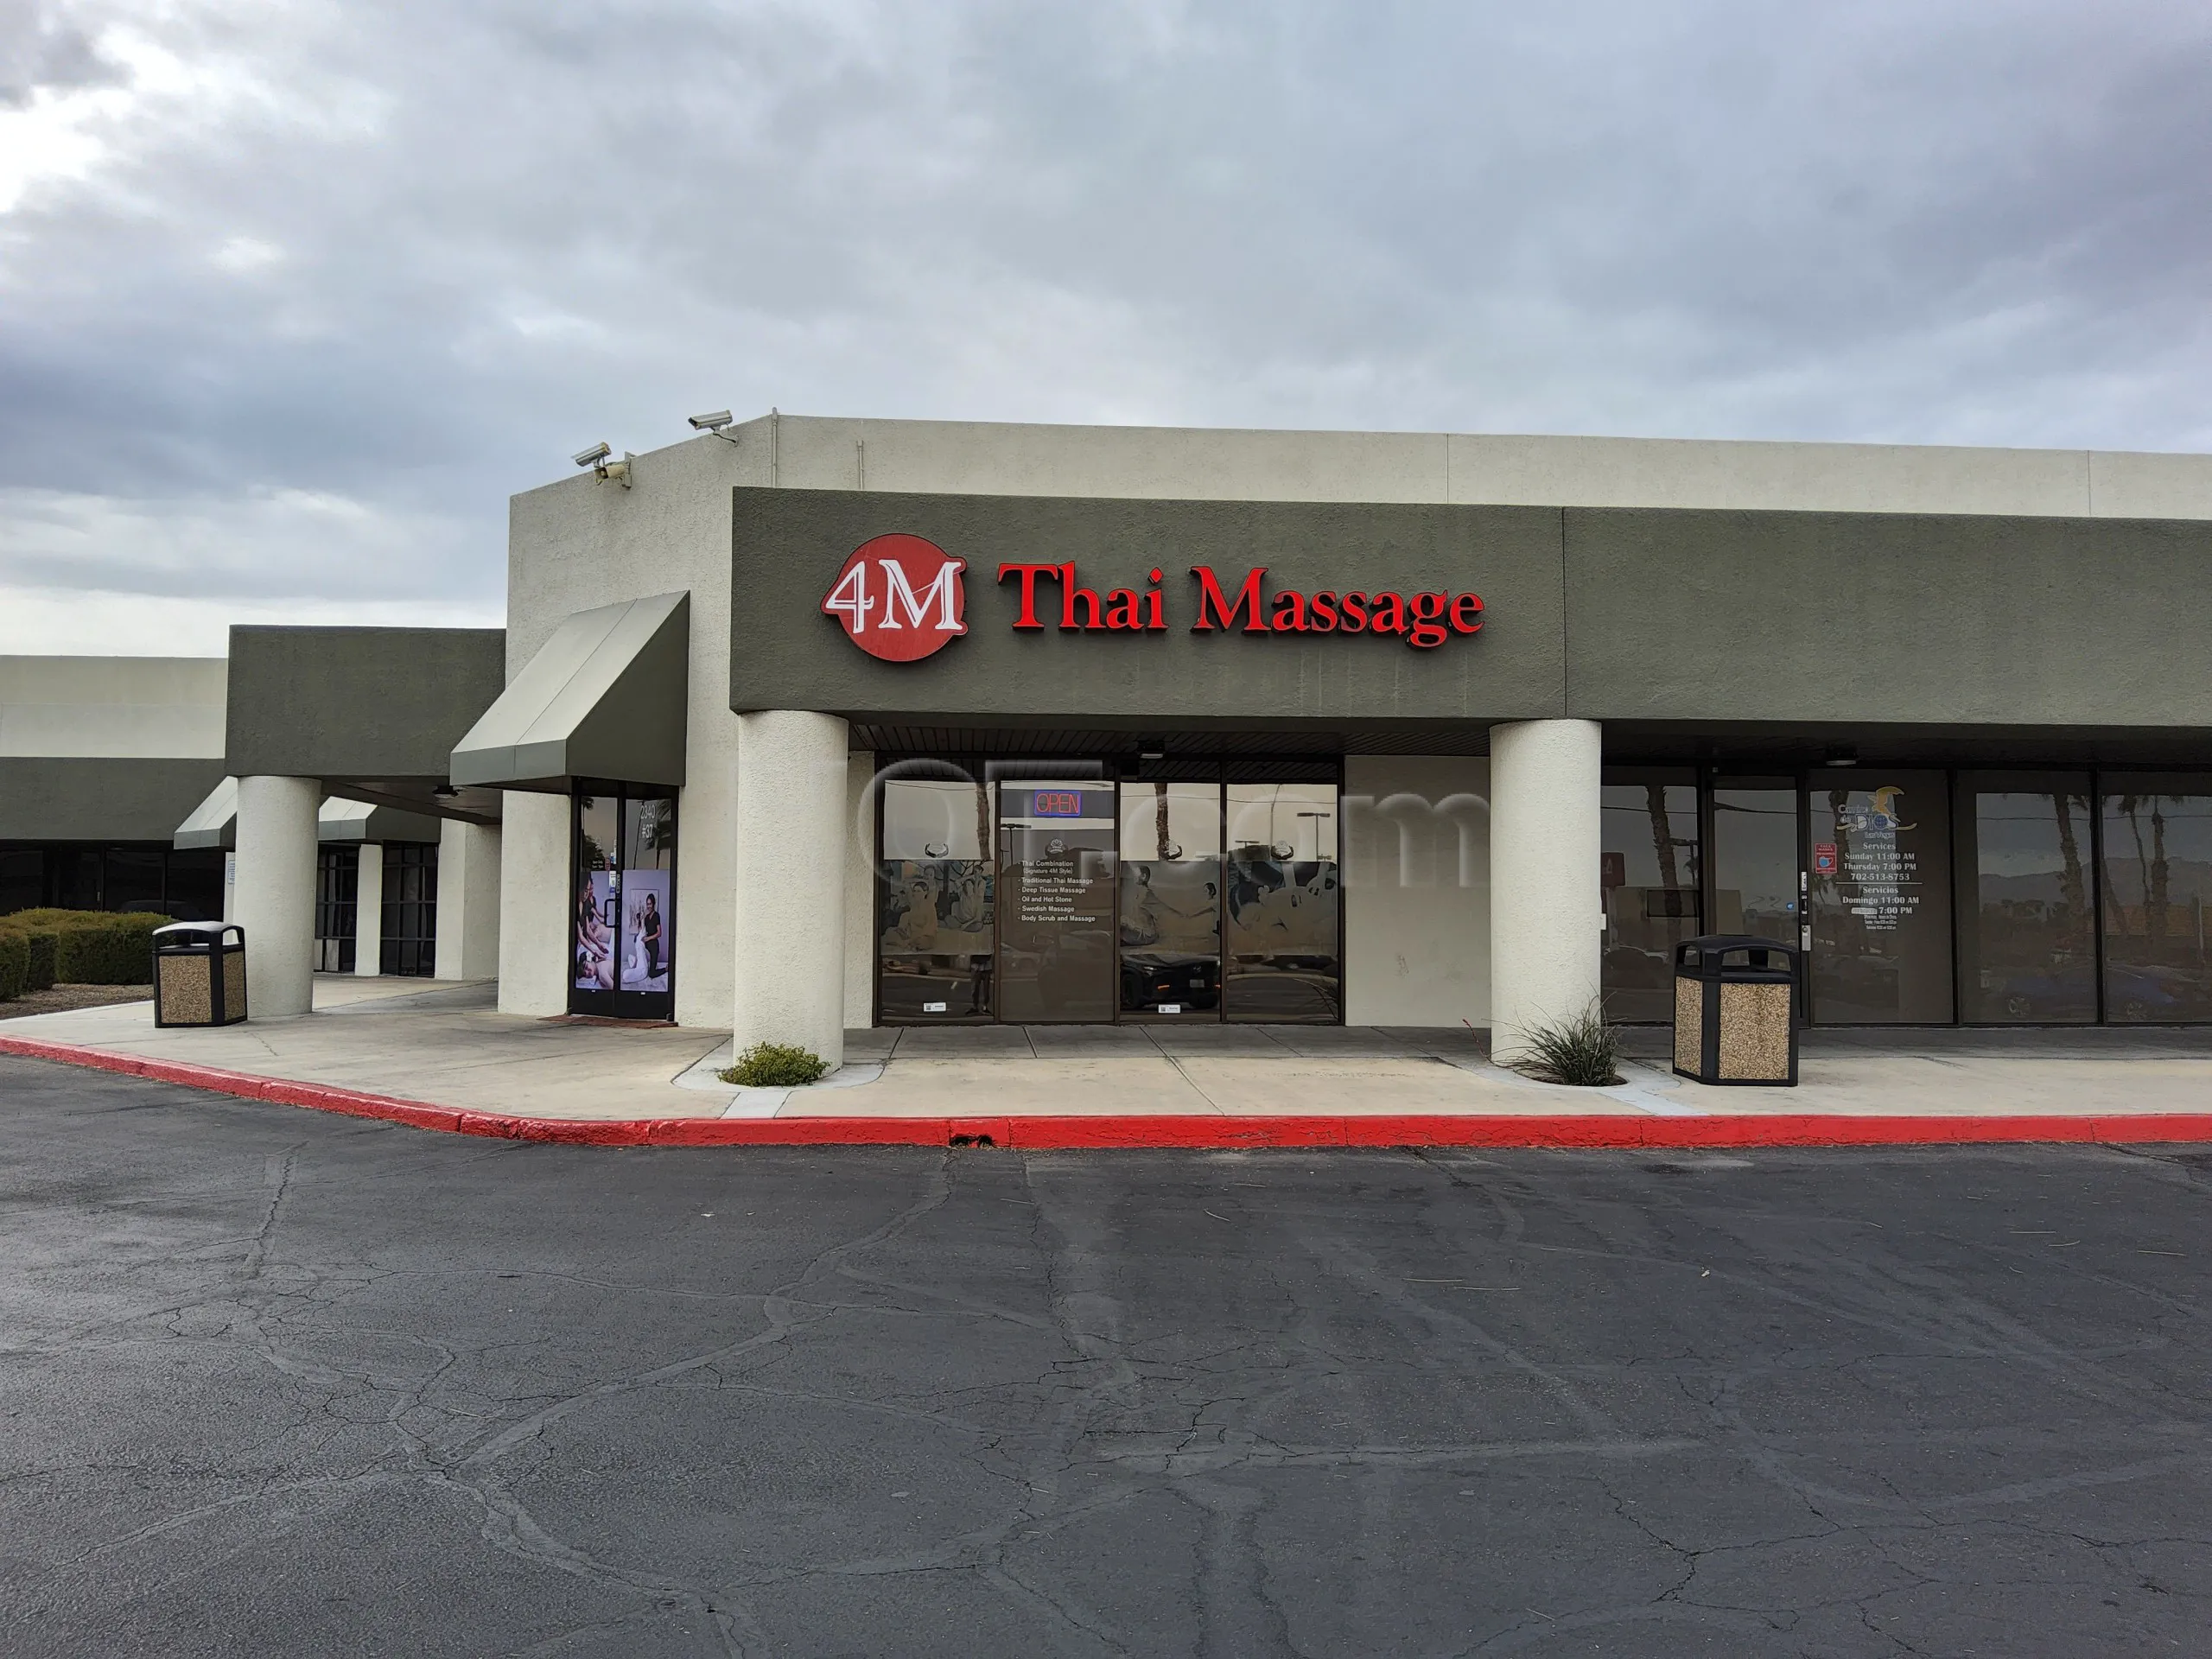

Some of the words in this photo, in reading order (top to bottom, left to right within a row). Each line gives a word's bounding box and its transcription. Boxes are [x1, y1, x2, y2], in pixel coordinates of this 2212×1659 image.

[825, 559, 963, 635] 4M
[999, 562, 1166, 629] Thai
[1192, 567, 1484, 646] Massage
[1036, 793, 1079, 814] OPEN
[640, 804, 656, 819] 2340
[1855, 813, 1898, 830] DIOS
[641, 823, 653, 839] #37
[1844, 852, 1874, 861] Sunday
[1877, 852, 1901, 861] 11:00
[1903, 852, 1915, 861] AM
[1843, 862, 1880, 872] Thursday
[1904, 862, 1916, 871] PM
[1862, 886, 1899, 894] Servicios
[1842, 896, 1878, 905] Domingo
[1881, 896, 1906, 905] 11:00
[1908, 896, 1920, 905] AM
